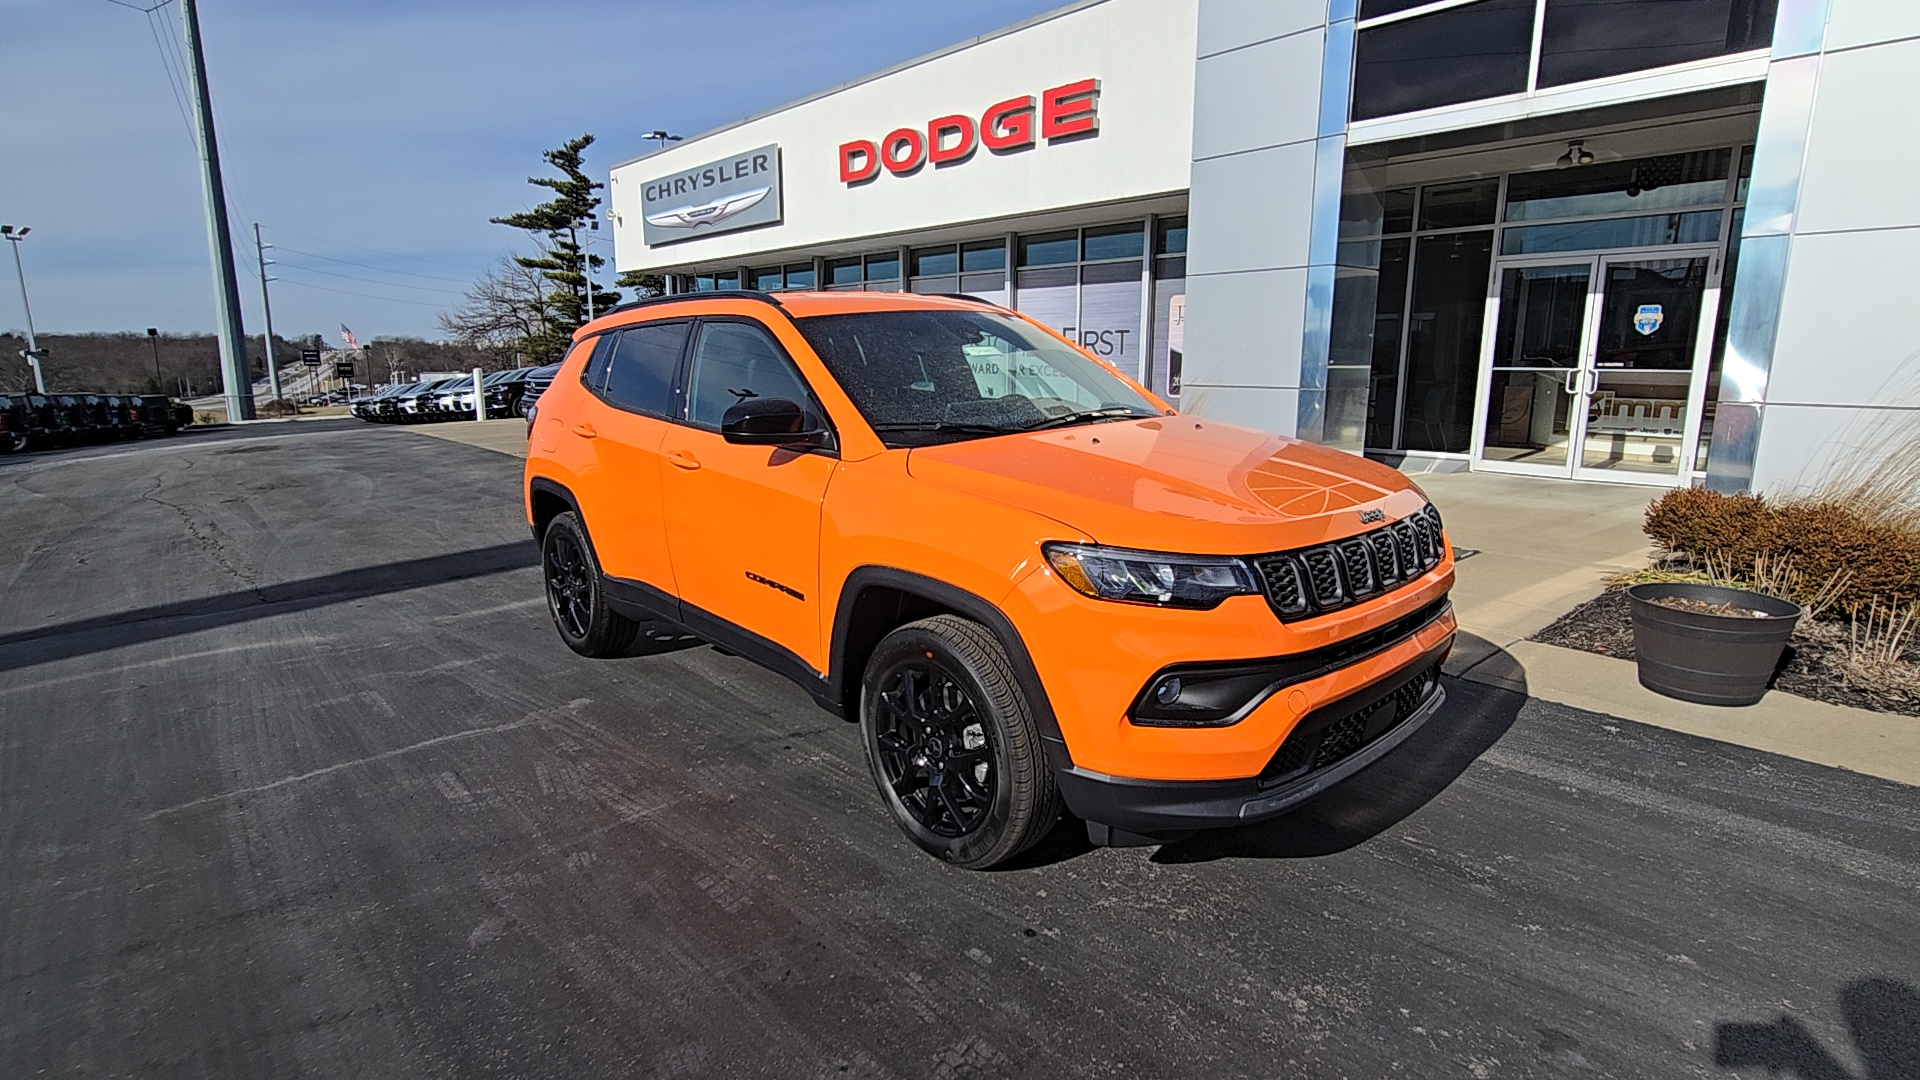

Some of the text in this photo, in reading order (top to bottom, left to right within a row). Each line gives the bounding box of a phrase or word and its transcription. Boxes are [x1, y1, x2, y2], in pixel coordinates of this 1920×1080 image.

[839, 78, 1100, 187] DODGE
[645, 154, 769, 203] CHRYSLER
[1062, 327, 1131, 356] FIRST
[969, 362, 1000, 375] WARD
